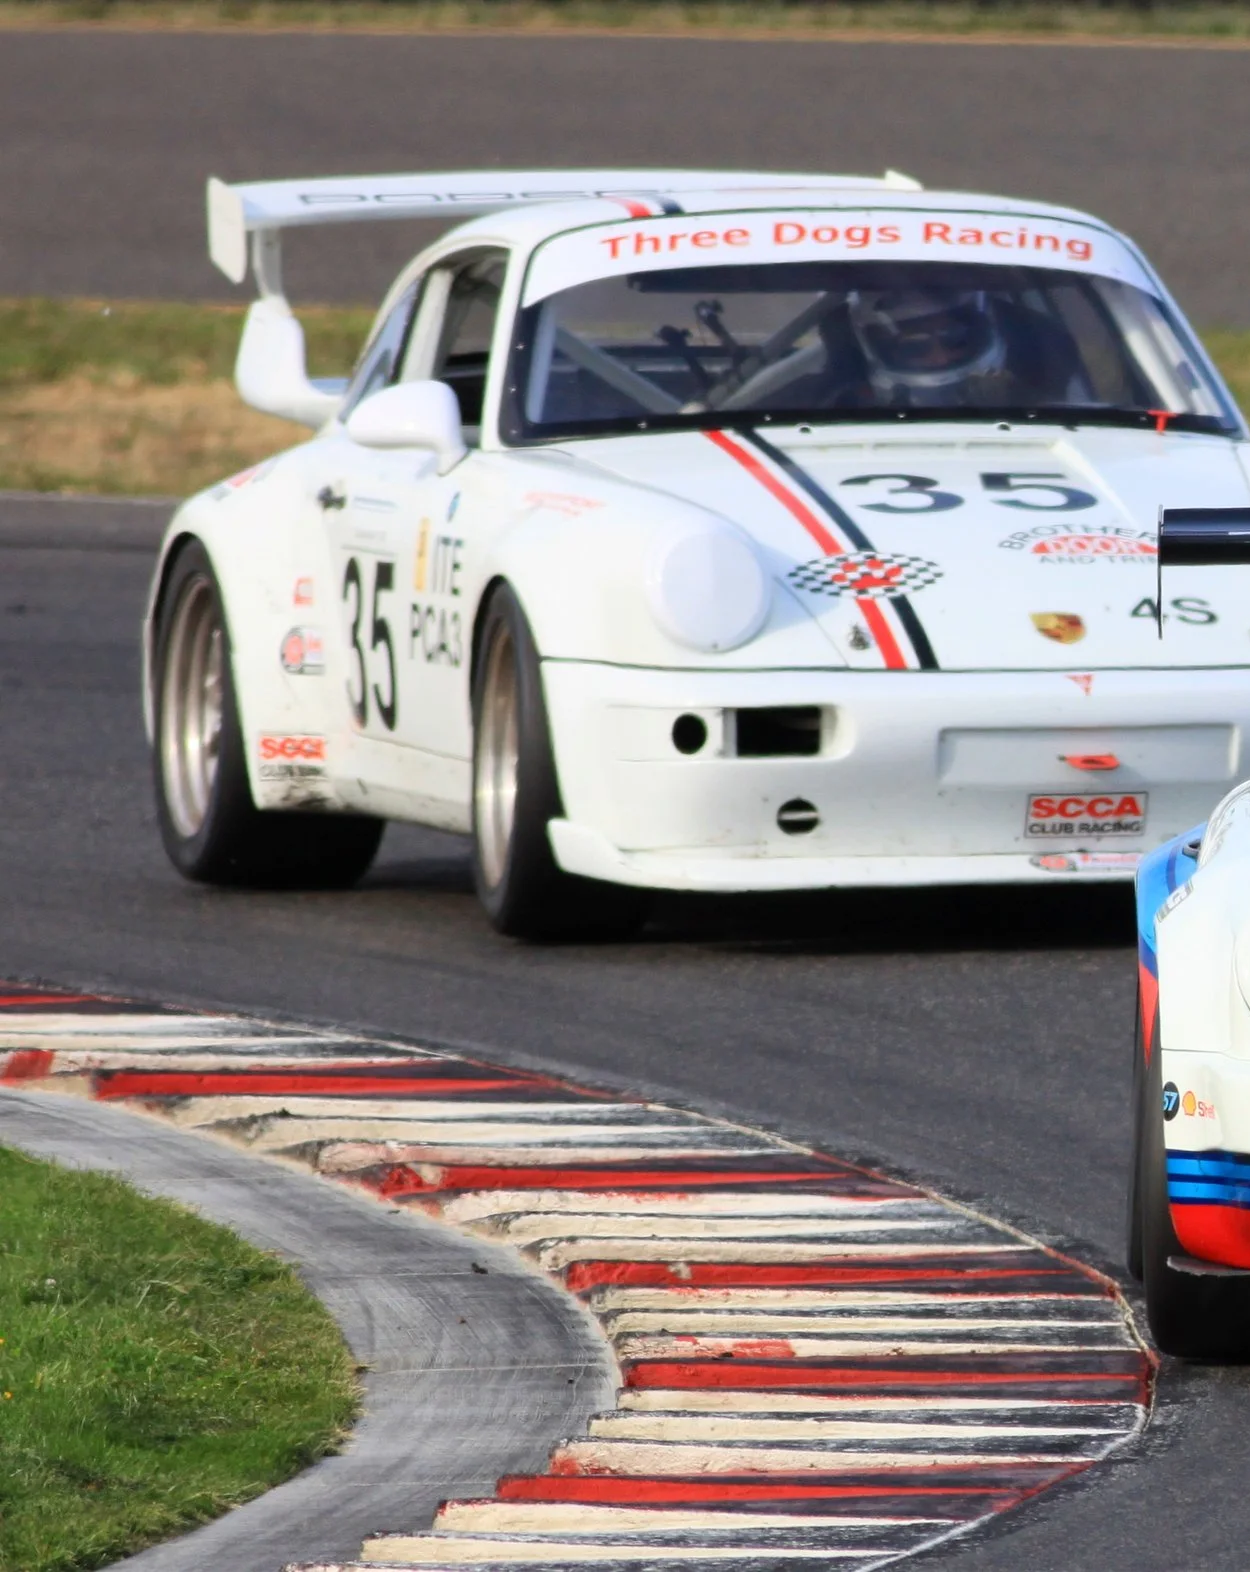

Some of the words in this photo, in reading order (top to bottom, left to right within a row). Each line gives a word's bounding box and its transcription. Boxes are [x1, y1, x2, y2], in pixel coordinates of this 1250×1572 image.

[600, 228, 750, 259] Three
[774, 222, 901, 249] Dogs
[923, 221, 1093, 261] Racing
[1040, 555, 1096, 565] AND
[1129, 597, 1218, 625] 4S
[342, 557, 398, 731] 35
[1031, 796, 1141, 819] SCCA
[1028, 822, 1074, 834] CLUB
[1078, 821, 1141, 834] RACING
